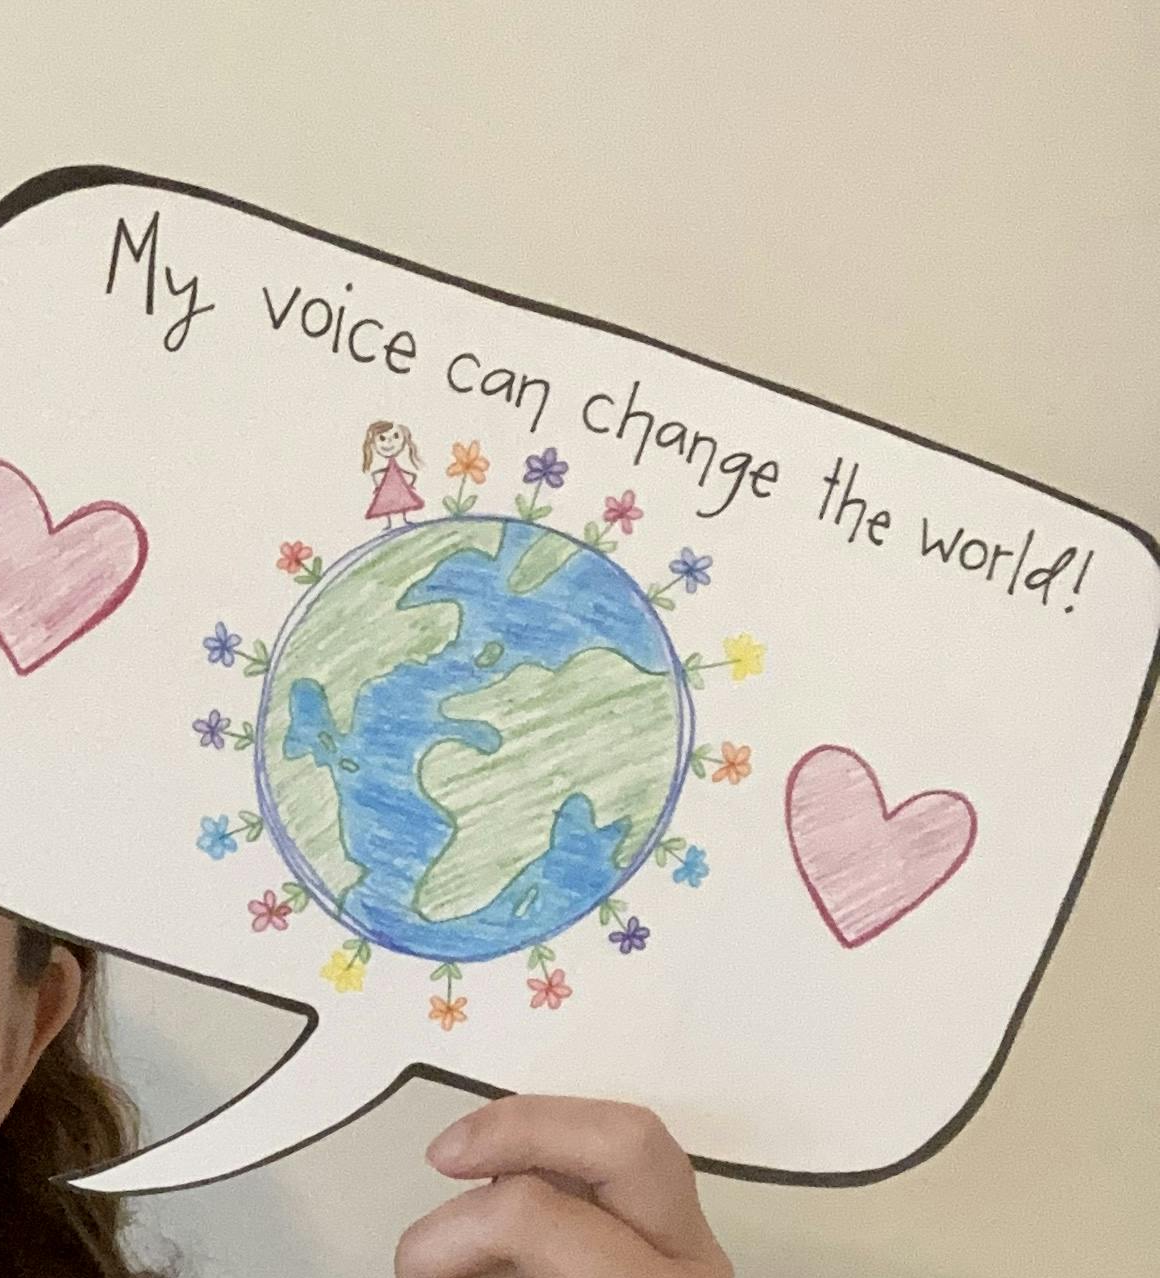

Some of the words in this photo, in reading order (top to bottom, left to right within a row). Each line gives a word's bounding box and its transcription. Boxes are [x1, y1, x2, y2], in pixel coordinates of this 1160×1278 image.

[104, 210, 216, 353] My
[262, 281, 417, 375] voice
[446, 352, 551, 434] can
[582, 380, 780, 519] change
[817, 456, 892, 547] the
[920, 517, 1095, 614] world!
